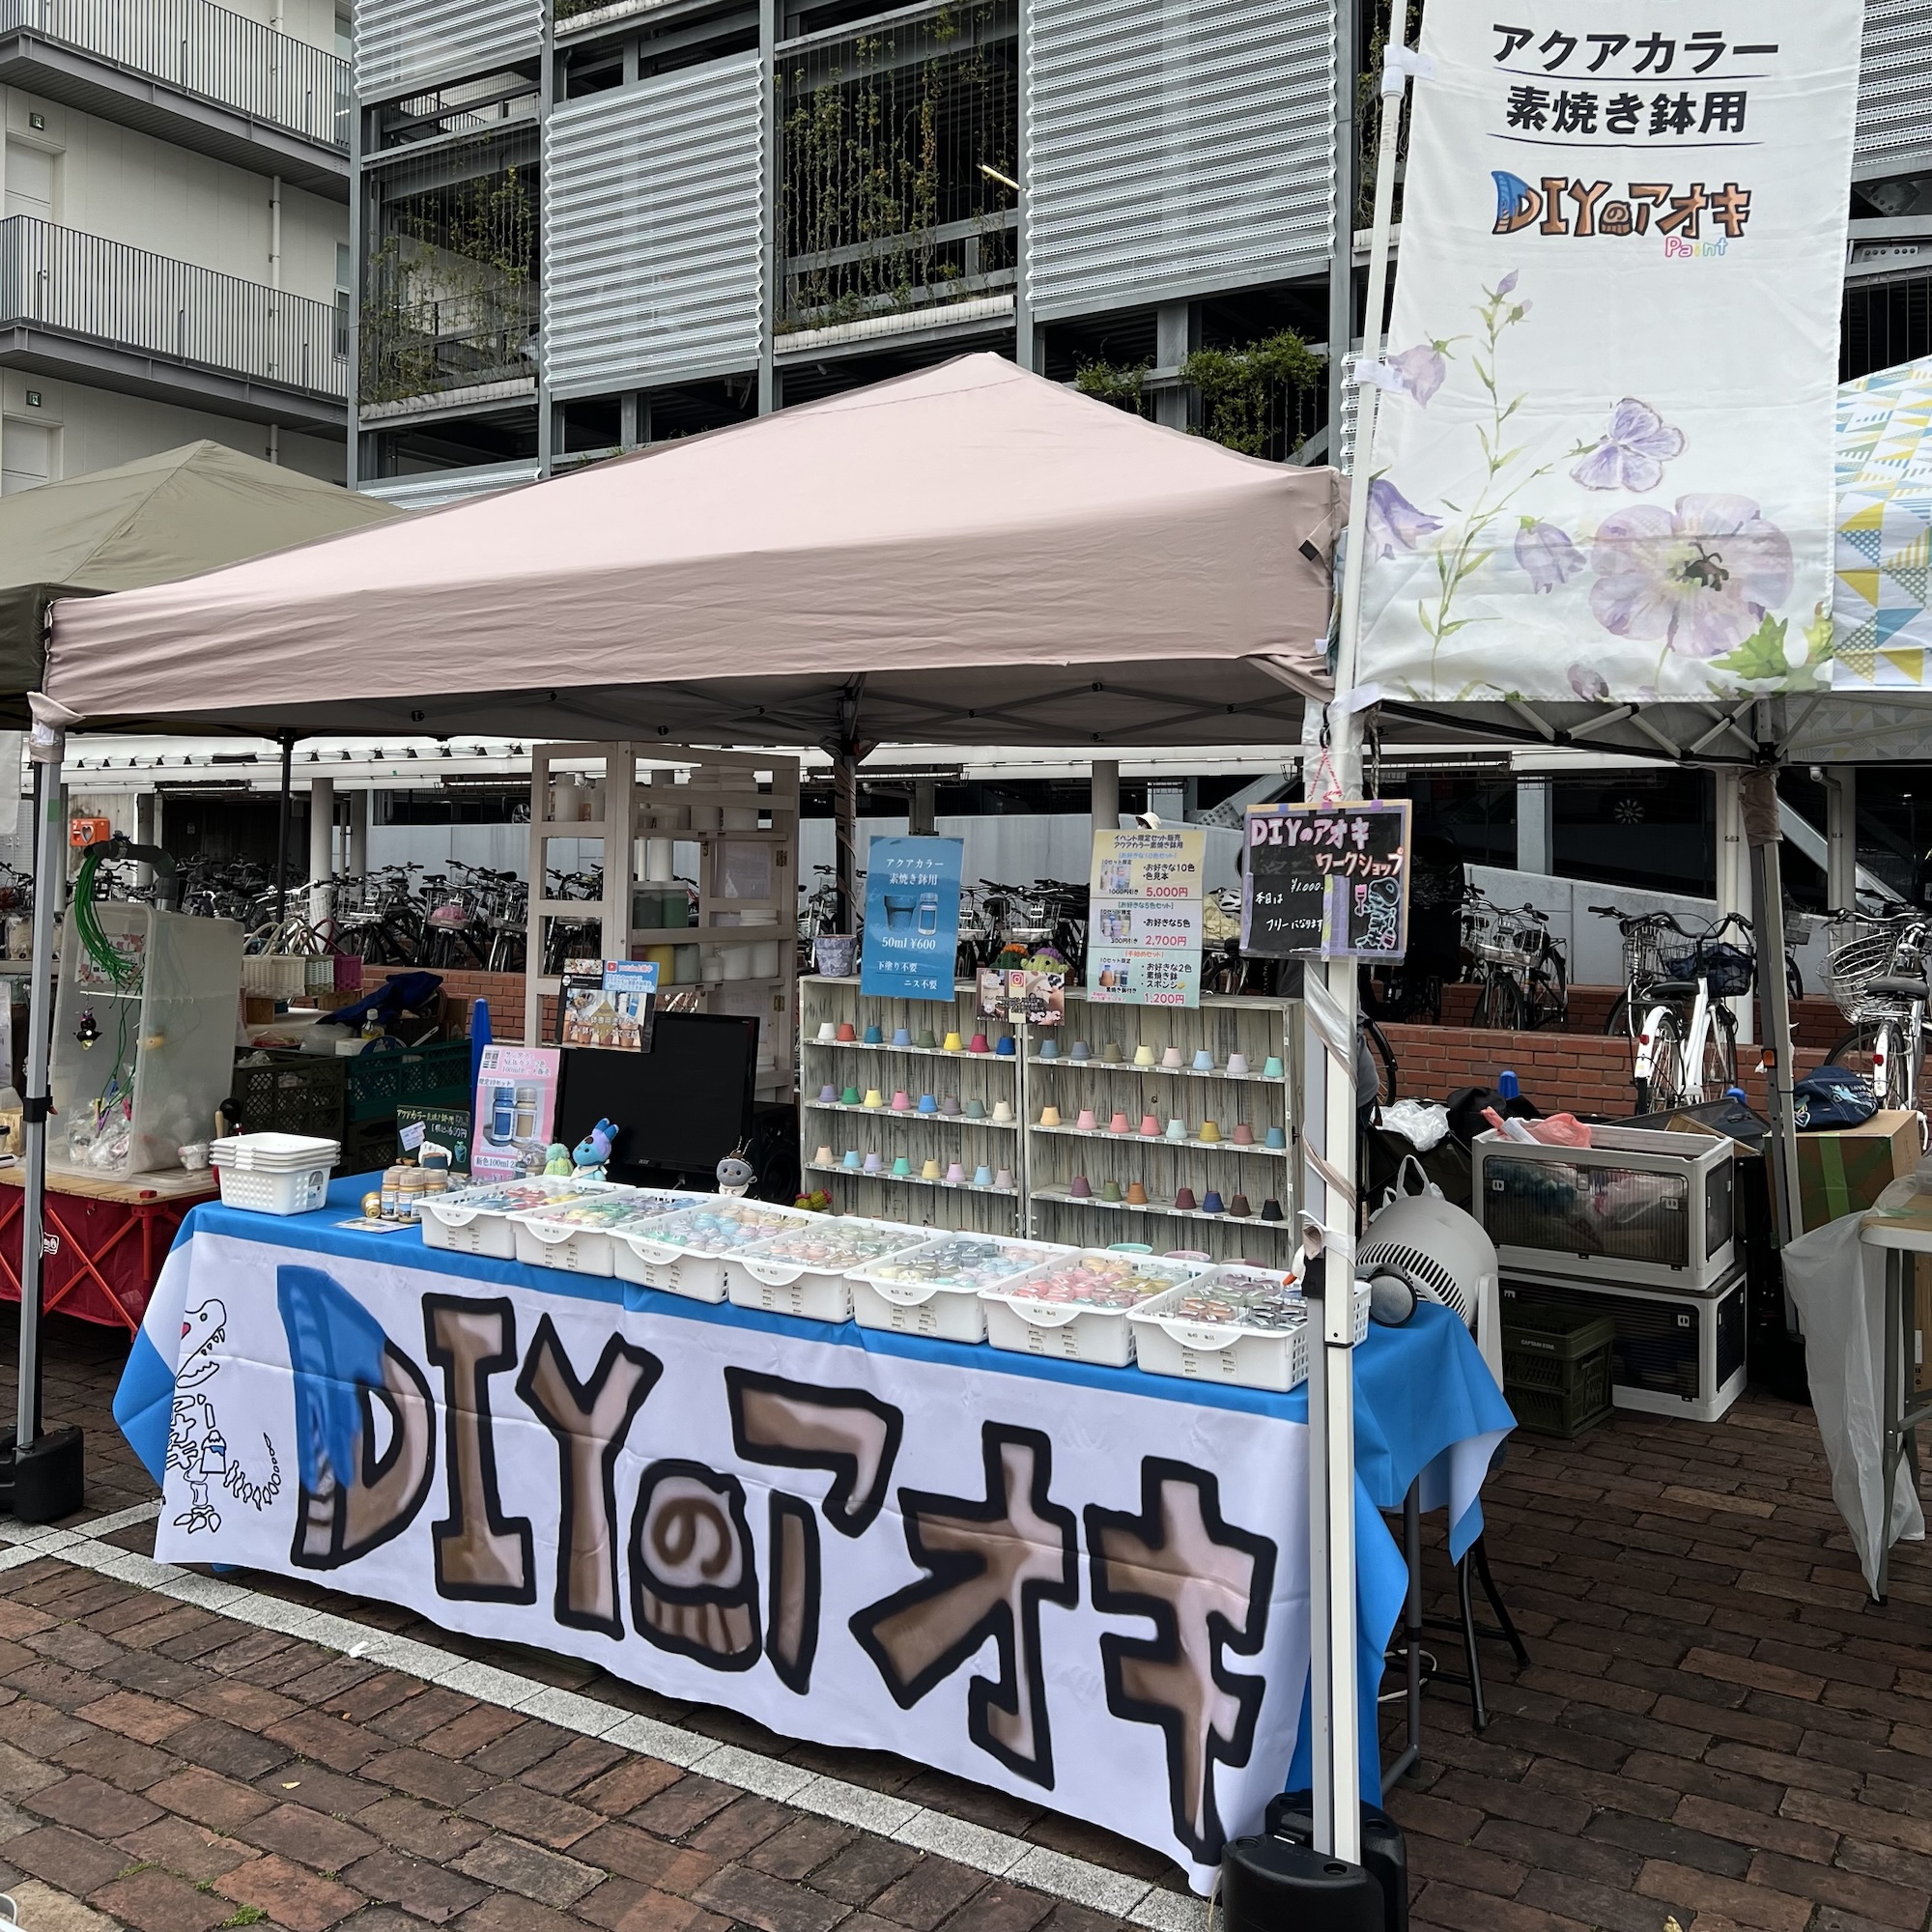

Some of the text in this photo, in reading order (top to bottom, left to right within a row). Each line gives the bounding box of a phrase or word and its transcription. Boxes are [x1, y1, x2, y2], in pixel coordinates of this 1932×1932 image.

[1492, 24, 1779, 74] アクアカラー
[1506, 85, 1747, 135] 素焼き鉢用
[1490, 170, 1752, 239] DIYのアオキ
[1663, 237, 1729, 258] Paint
[1114, 834, 1181, 842] イベント限定セット販売
[1249, 816, 1370, 850] DIYのアオキ
[886, 859, 944, 868] アクアカラー
[1315, 847, 1404, 877] ワークショップ
[889, 873, 938, 886] 素焼き鉢用
[1146, 887, 1188, 897] 5,000円
[1255, 892, 1284, 905] 本日は
[1265, 918, 1323, 932] フリーになります
[881, 936, 936, 950] 50ml ¥600
[1145, 936, 1187, 946] 2,700円
[877, 960, 918, 973] 下塗り不要
[903, 979, 938, 990] ニス不要
[1144, 993, 1186, 1004] 1,200円
[275, 1263, 1278, 1863] DIYのアオキ
